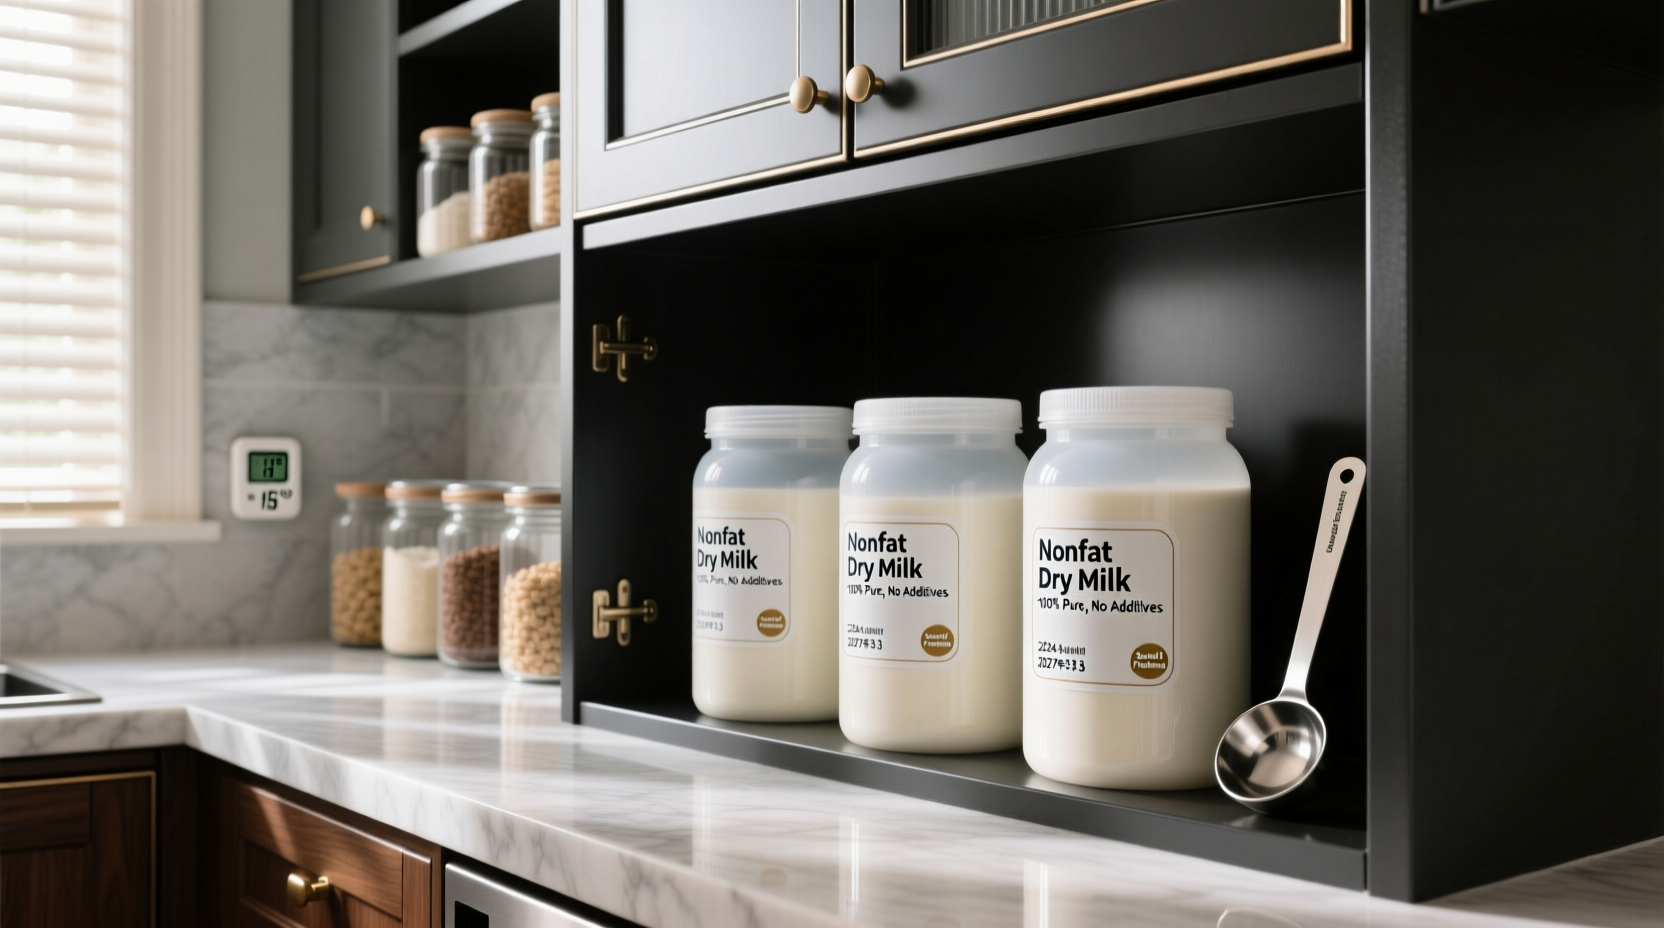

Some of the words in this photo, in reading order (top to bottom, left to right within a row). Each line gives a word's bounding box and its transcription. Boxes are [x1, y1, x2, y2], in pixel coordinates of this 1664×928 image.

[697, 525, 746, 546] Nonfat
[848, 530, 907, 553] Nonfat
[697, 548, 718, 573] Dry
[721, 549, 758, 570] Milk
[1039, 538, 1113, 563] Nonfat
[848, 556, 875, 582] Dry
[879, 557, 923, 578] Milk
[1039, 567, 1073, 596] Dry
[1078, 566, 1132, 592] Milk
[888, 585, 900, 597] No
[1092, 600, 1108, 612] No
[1110, 600, 1164, 613] Additives
